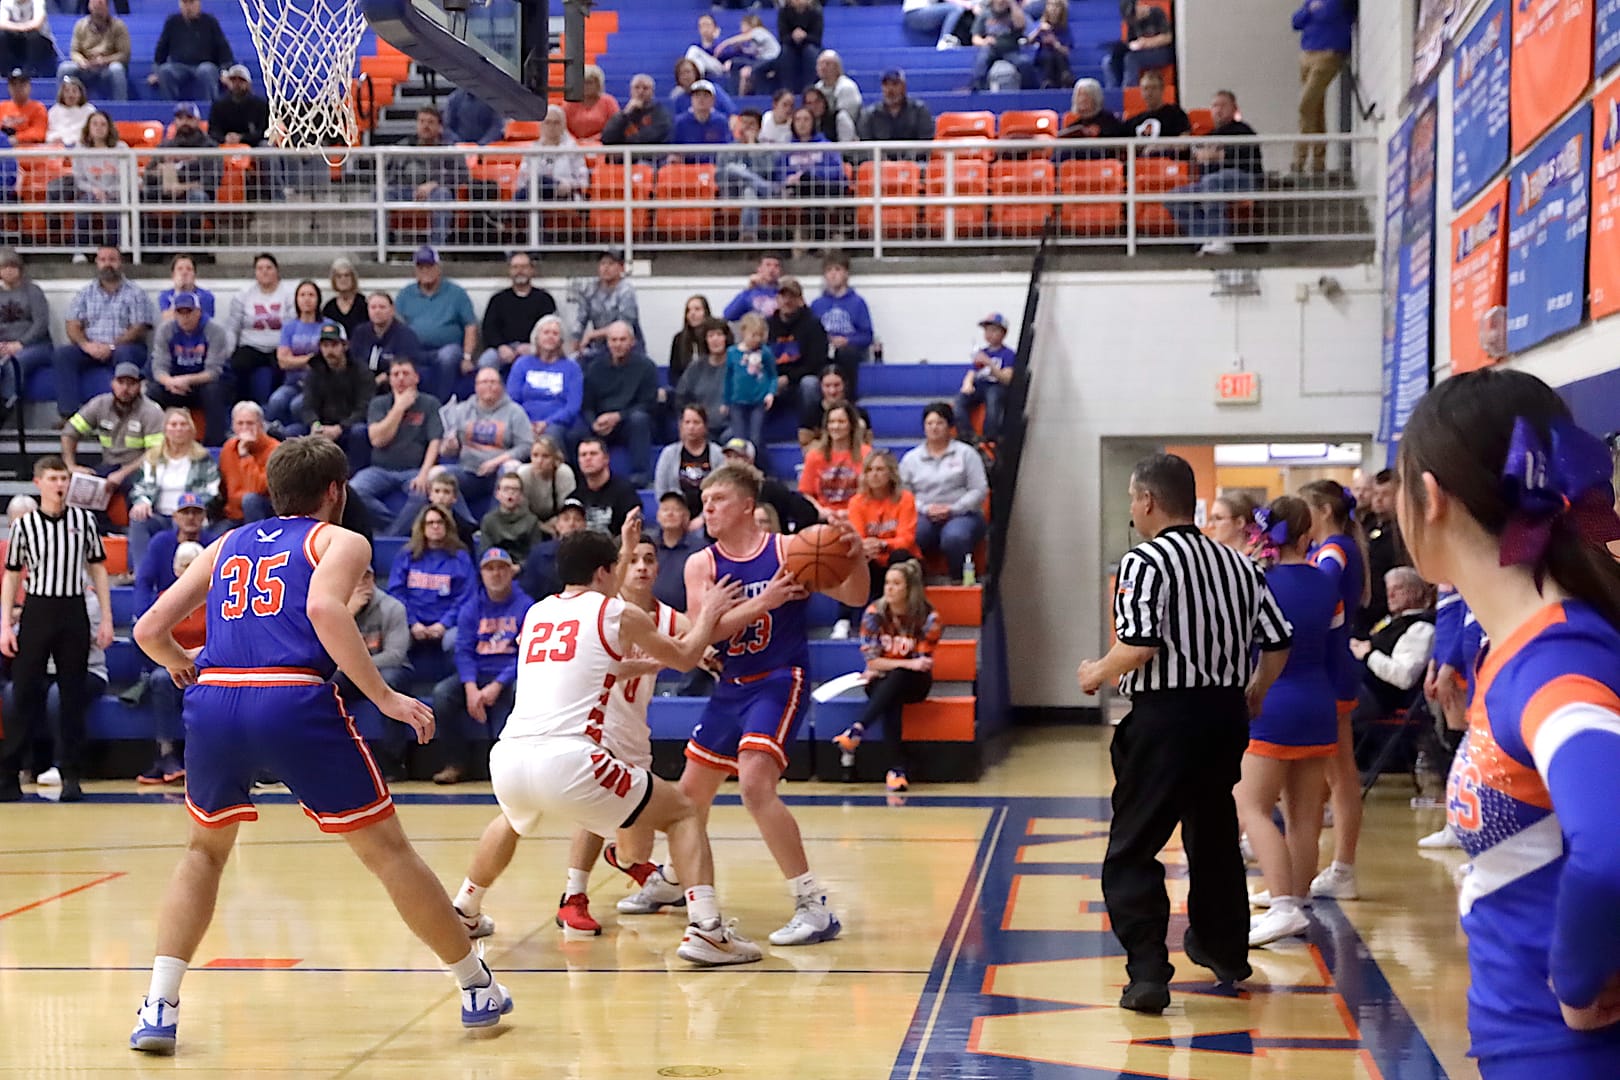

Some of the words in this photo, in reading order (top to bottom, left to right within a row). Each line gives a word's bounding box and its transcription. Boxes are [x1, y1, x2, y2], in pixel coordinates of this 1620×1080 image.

[1221, 374, 1252, 398] EXIT
[221, 550, 290, 621] 35
[525, 619, 580, 664] 23
[727, 610, 772, 656] 23
